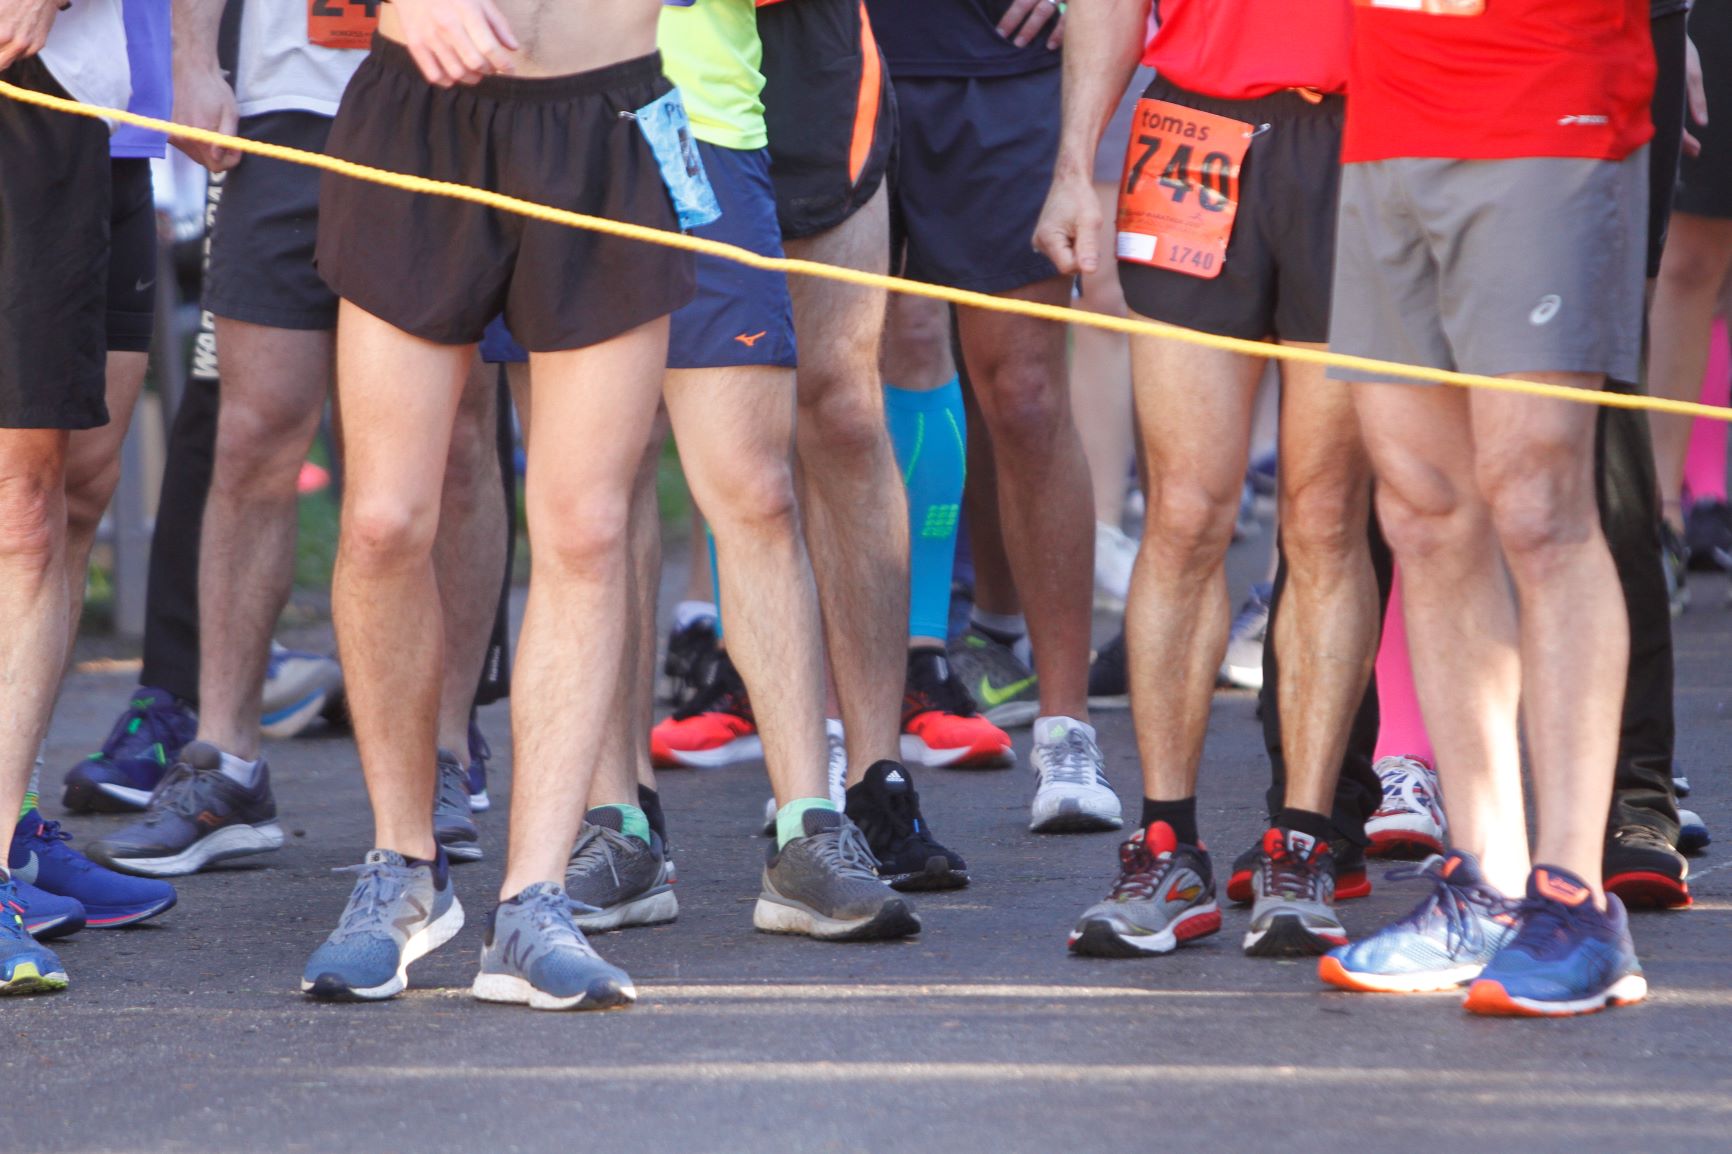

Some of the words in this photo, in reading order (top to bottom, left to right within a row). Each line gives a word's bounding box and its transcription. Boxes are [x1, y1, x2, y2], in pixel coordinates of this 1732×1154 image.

[1142, 110, 1210, 141] tomas
[1125, 135, 1232, 212] 740
[1169, 244, 1215, 270] 1740
